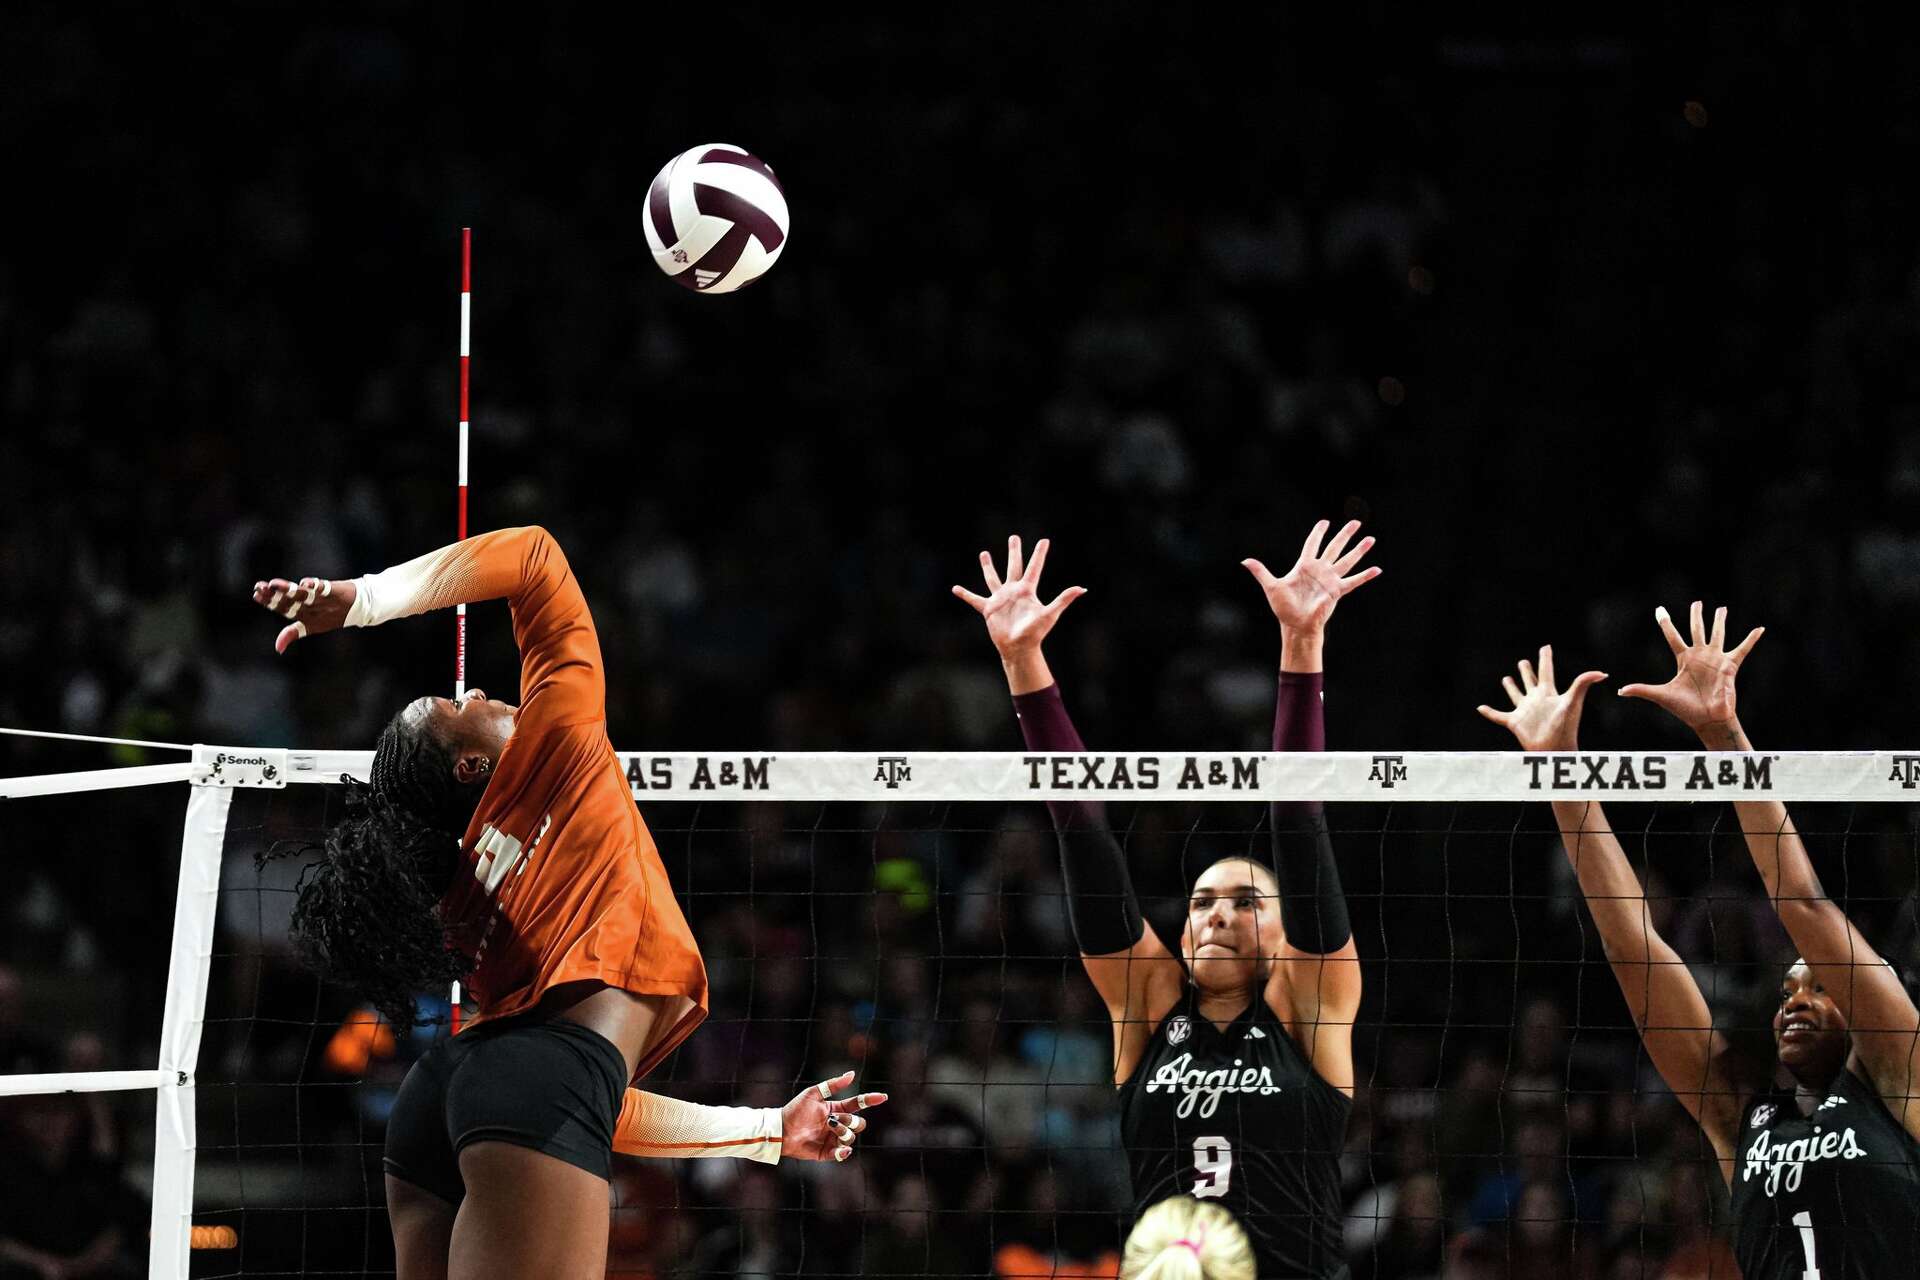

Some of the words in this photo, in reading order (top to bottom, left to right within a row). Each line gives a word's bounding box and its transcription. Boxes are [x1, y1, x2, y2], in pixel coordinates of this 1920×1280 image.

[227, 755, 267, 766] Senoh
[617, 757, 673, 790] AS
[689, 757, 770, 790] A&M
[1023, 756, 1160, 790] TEXAS
[1177, 756, 1260, 790] A&M
[1523, 756, 1667, 790] TEXAS
[1685, 756, 1773, 790] A&M
[1146, 1052, 1281, 1119] Aggies
[1191, 1136, 1233, 1199] 9
[1743, 1127, 1868, 1198] Aggies
[1792, 1211, 1821, 1280] 1
